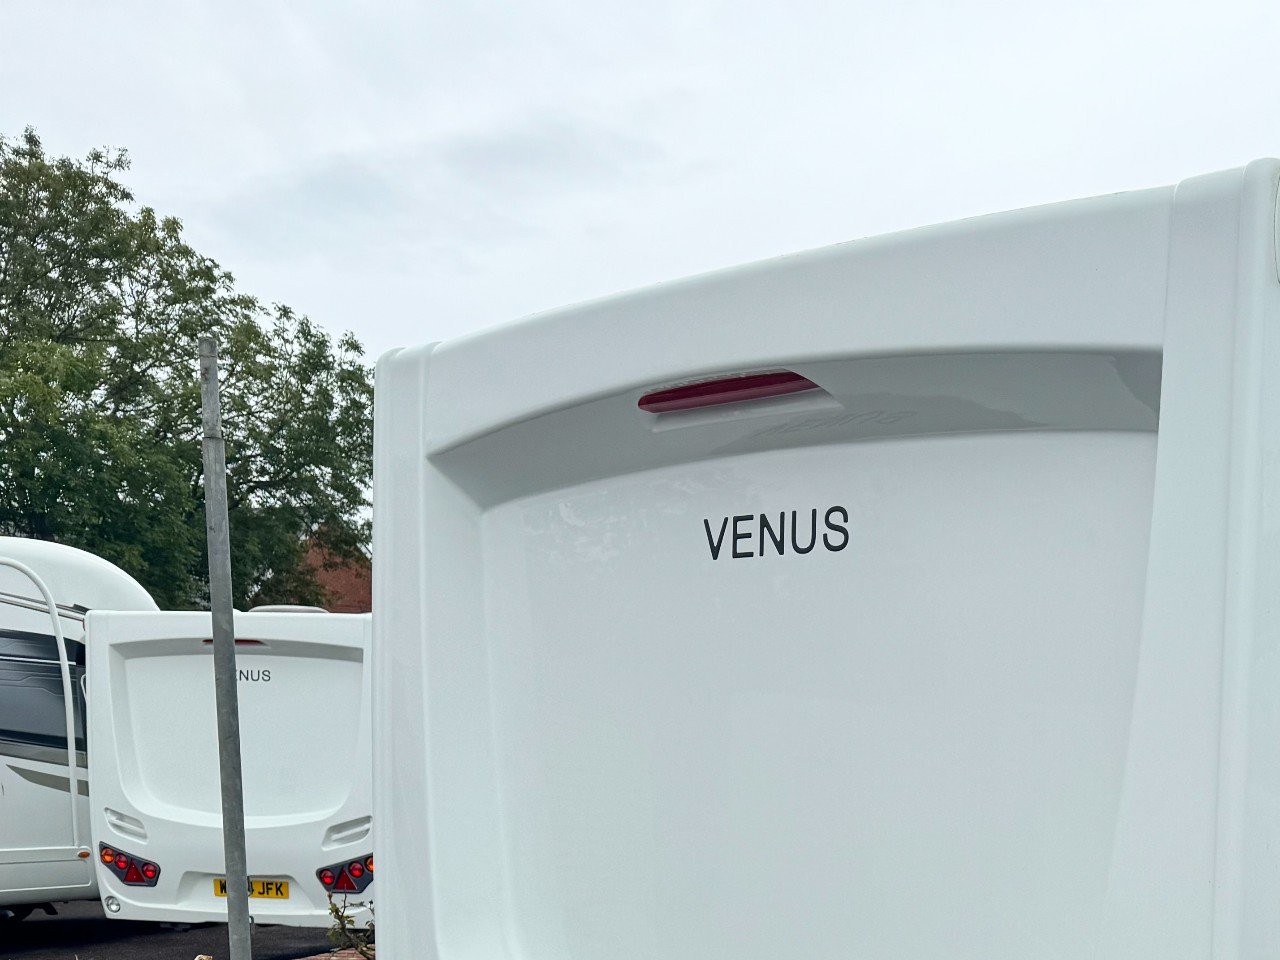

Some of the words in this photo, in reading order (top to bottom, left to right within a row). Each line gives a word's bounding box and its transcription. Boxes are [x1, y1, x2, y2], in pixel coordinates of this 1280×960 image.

[703, 505, 850, 561] VENUS
[236, 669, 272, 682] NUS
[258, 881, 284, 896] JFK
